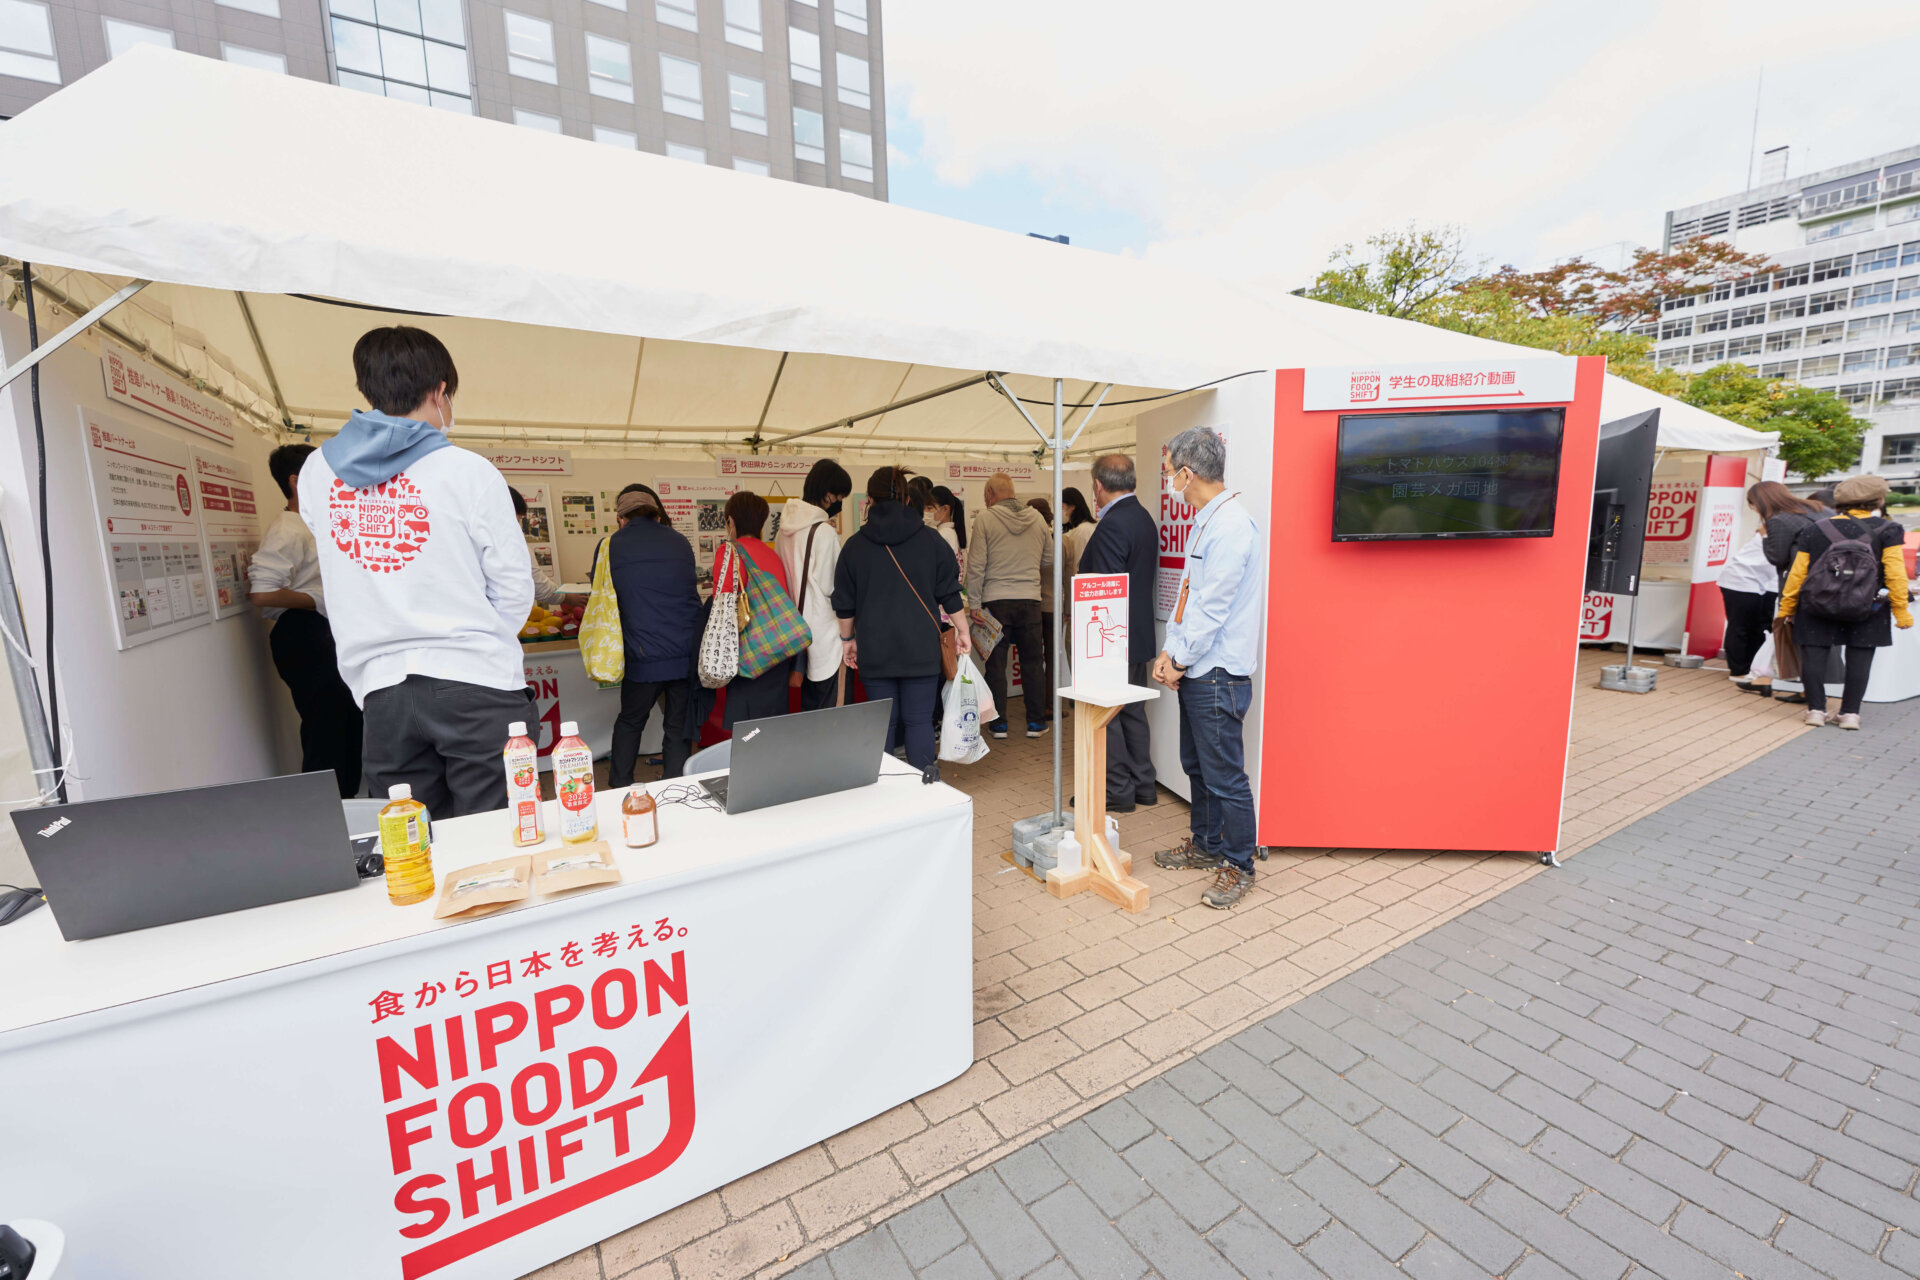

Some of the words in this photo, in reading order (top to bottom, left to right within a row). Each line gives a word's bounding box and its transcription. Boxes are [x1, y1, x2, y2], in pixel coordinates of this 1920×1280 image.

[1351, 375, 1380, 383] NIPPON
[1389, 371, 1516, 389] 学生の取組紹介動画
[1350, 383, 1372, 391] FOOD
[1350, 390, 1374, 399] SHIFT
[485, 455, 565, 465] ッポンフードシフト
[1387, 455, 1509, 470] トマトハウス104棟
[1392, 480, 1498, 498] 園芸メガ団地
[1649, 490, 1698, 504] PPON
[359, 504, 395, 514] NIPPON
[1161, 494, 1196, 521] FOO
[1649, 506, 1675, 519] OD
[359, 514, 386, 523] FOOD
[359, 523, 389, 533] SHIFT
[1648, 521, 1680, 534] IFT
[1160, 525, 1192, 552] SHI
[1081, 581, 1120, 589] アルコール消毒に
[1080, 589, 1123, 598] ご協力お願いします
[1583, 595, 1614, 608] PON
[568, 792, 587, 802] 2022
[37, 816, 73, 838] ThinkPad
[368, 917, 688, 1024] 食から日本を考える。
[376, 950, 689, 1104] NIPPON
[386, 1045, 618, 1176] FOOD
[394, 1094, 644, 1239] SHIFT
